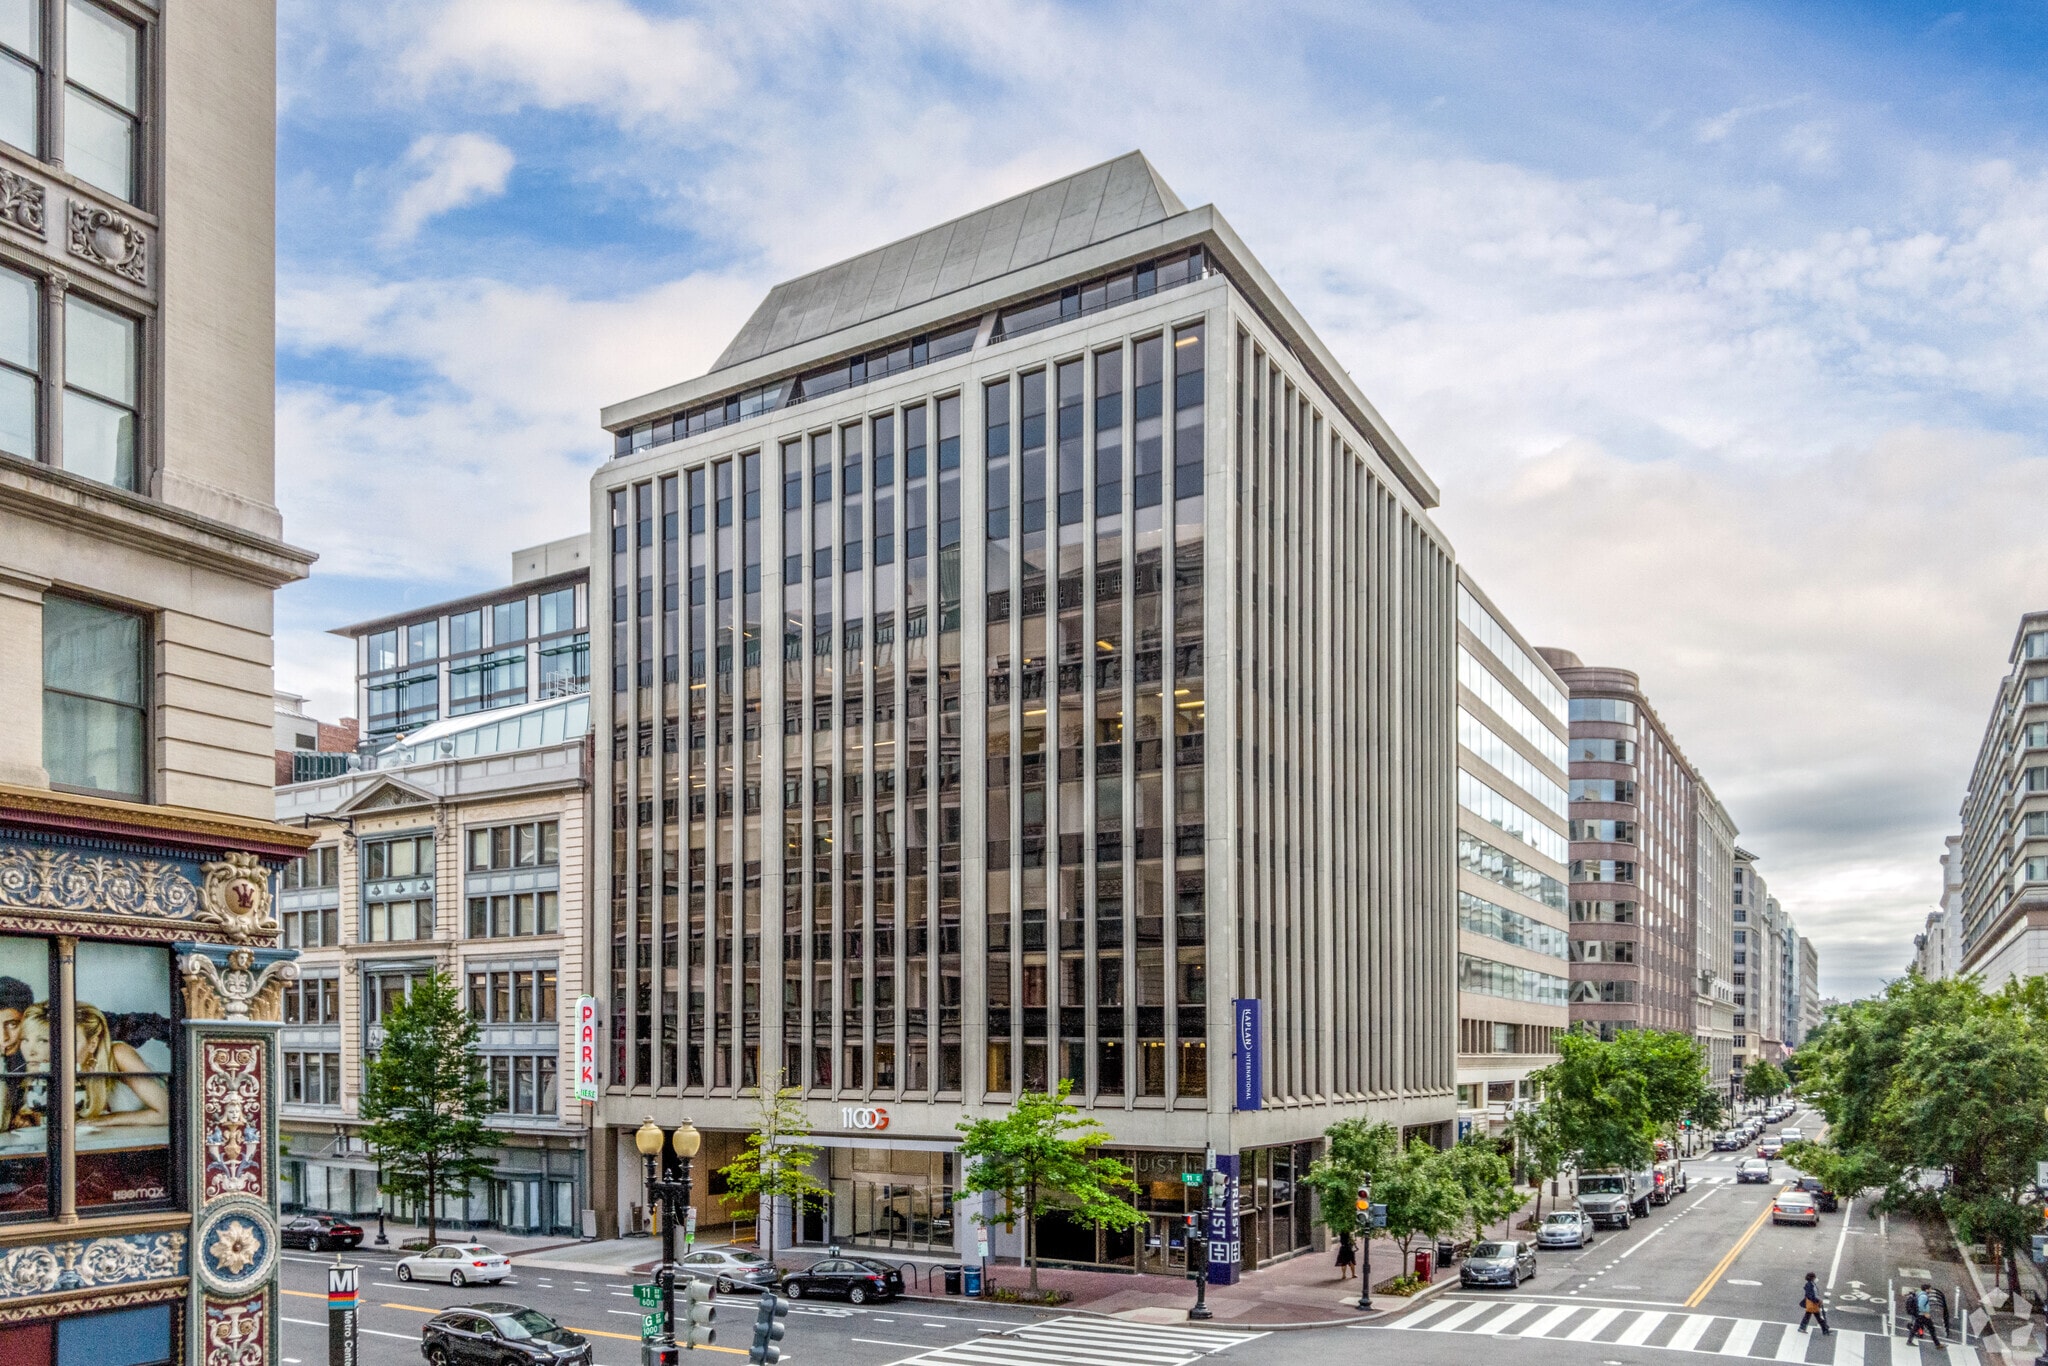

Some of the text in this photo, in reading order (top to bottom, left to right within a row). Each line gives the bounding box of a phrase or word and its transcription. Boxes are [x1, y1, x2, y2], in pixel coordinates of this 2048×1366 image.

[582, 1006, 593, 1083] PARK
[580, 1088, 596, 1098] HERE
[1231, 1176, 1239, 1237] TRUIST
[329, 1270, 353, 1292] M
[641, 1287, 651, 1298] 11
[642, 1299, 655, 1307] 600
[344, 1311, 353, 1338] Metro
[645, 1315, 653, 1327] G
[643, 1325, 658, 1337] 1000
